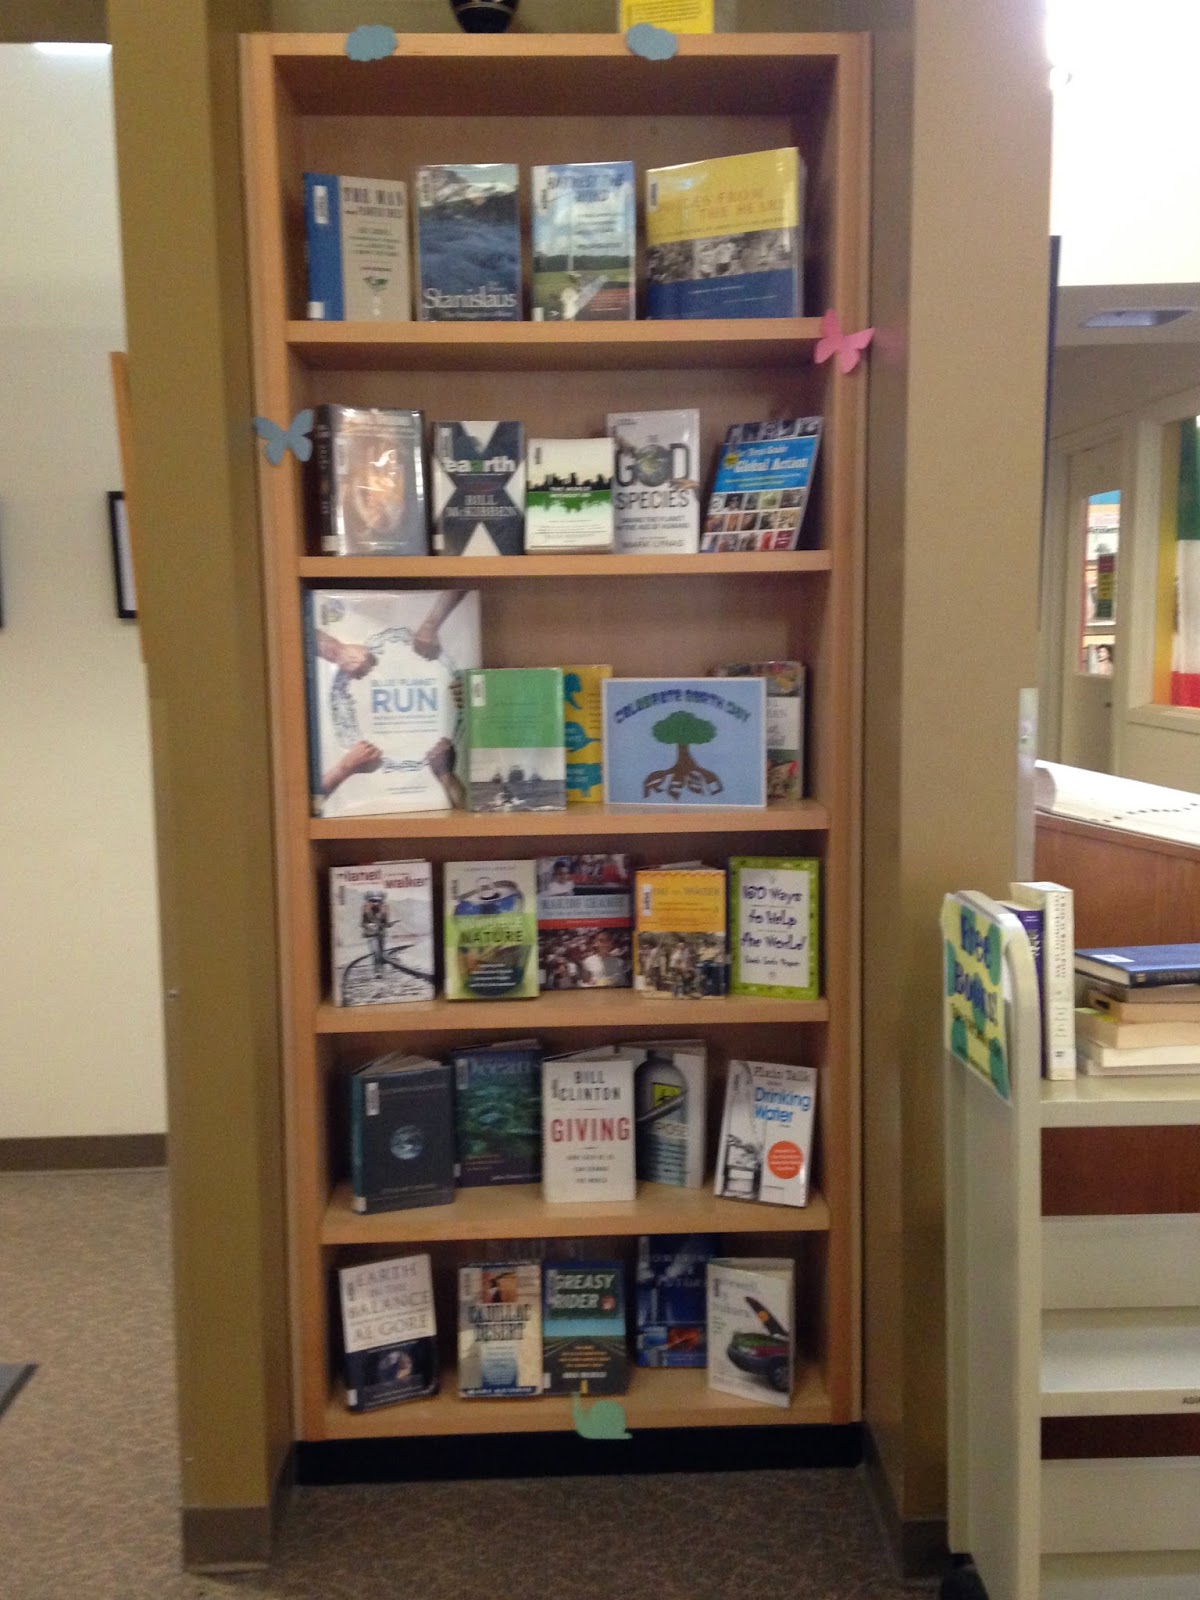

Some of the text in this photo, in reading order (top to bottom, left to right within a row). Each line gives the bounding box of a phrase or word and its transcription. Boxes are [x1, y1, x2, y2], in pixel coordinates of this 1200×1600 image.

[422, 285, 518, 309] Stanislaus
[615, 442, 691, 488] GOD
[614, 490, 690, 510] SPECIES
[370, 687, 439, 713] RUN
[769, 886, 803, 905] Ways
[458, 930, 524, 944] NATURE
[573, 1070, 606, 1084] BILL
[559, 1087, 622, 1101] CLINTON
[754, 1086, 812, 1112] Drinking
[754, 1105, 794, 1123] Water
[551, 1117, 631, 1143] GIVING
[555, 1274, 616, 1290] GREASY
